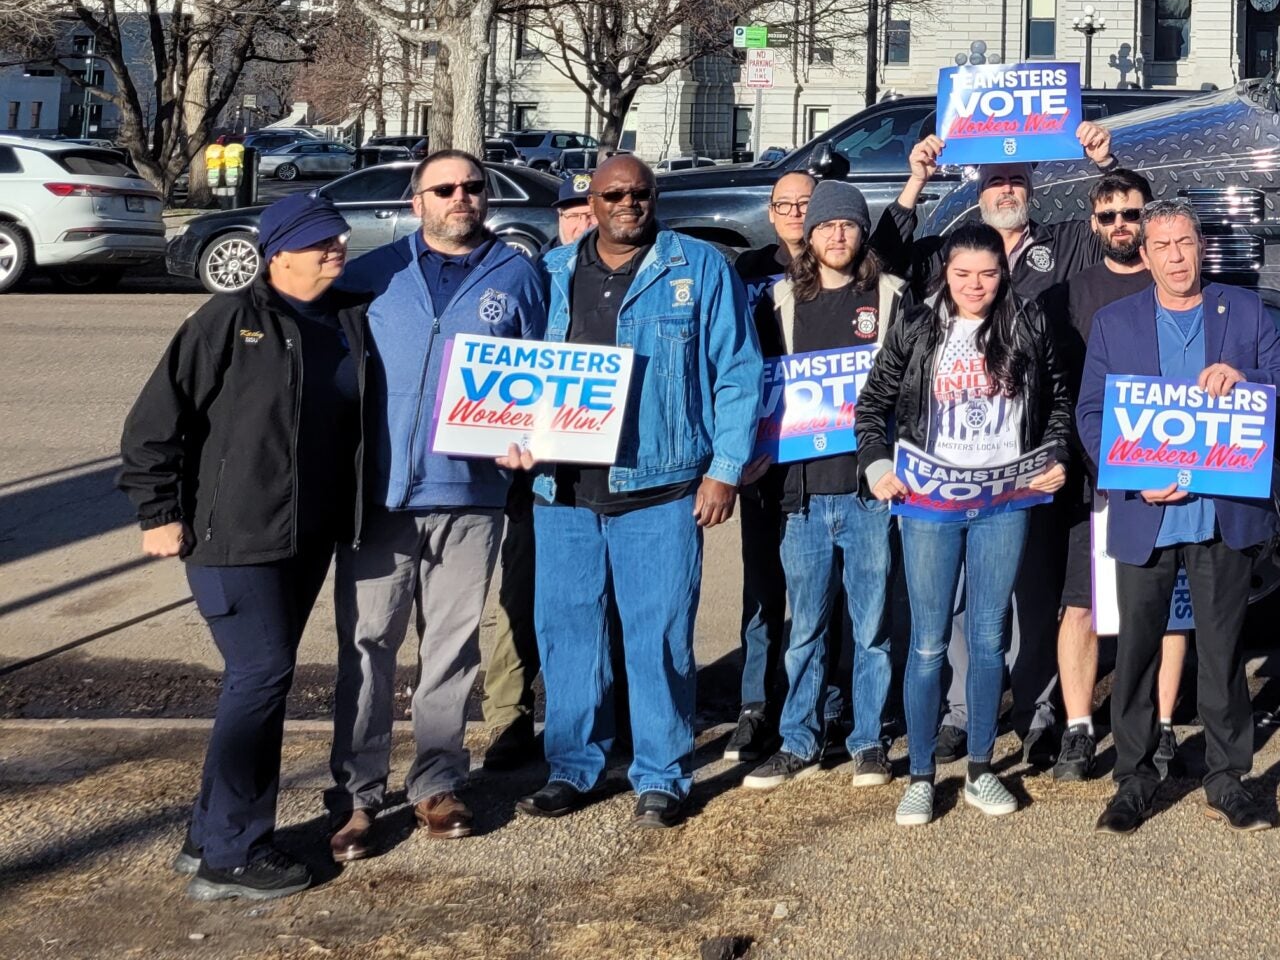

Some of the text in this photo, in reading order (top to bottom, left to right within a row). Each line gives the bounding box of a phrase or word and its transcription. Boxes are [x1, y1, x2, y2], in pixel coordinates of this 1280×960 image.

[750, 59, 772, 67] PARKING
[756, 50, 766, 58] NO
[949, 69, 1067, 90] TEAMSTERS
[949, 88, 1068, 118] VOTE
[948, 108, 1070, 134] Workers Win!
[464, 341, 621, 374] TEAMSTERS
[763, 349, 878, 383] EAMSTER
[460, 367, 617, 411] VOTE
[448, 396, 616, 432] Worker Win!
[1114, 407, 1266, 449] VOTE
[937, 440, 973, 451] AMSTERS
[1106, 435, 1266, 470] Workers Win!
[906, 451, 1049, 483] TEAMSTERS
[904, 466, 1047, 501] VOTE
